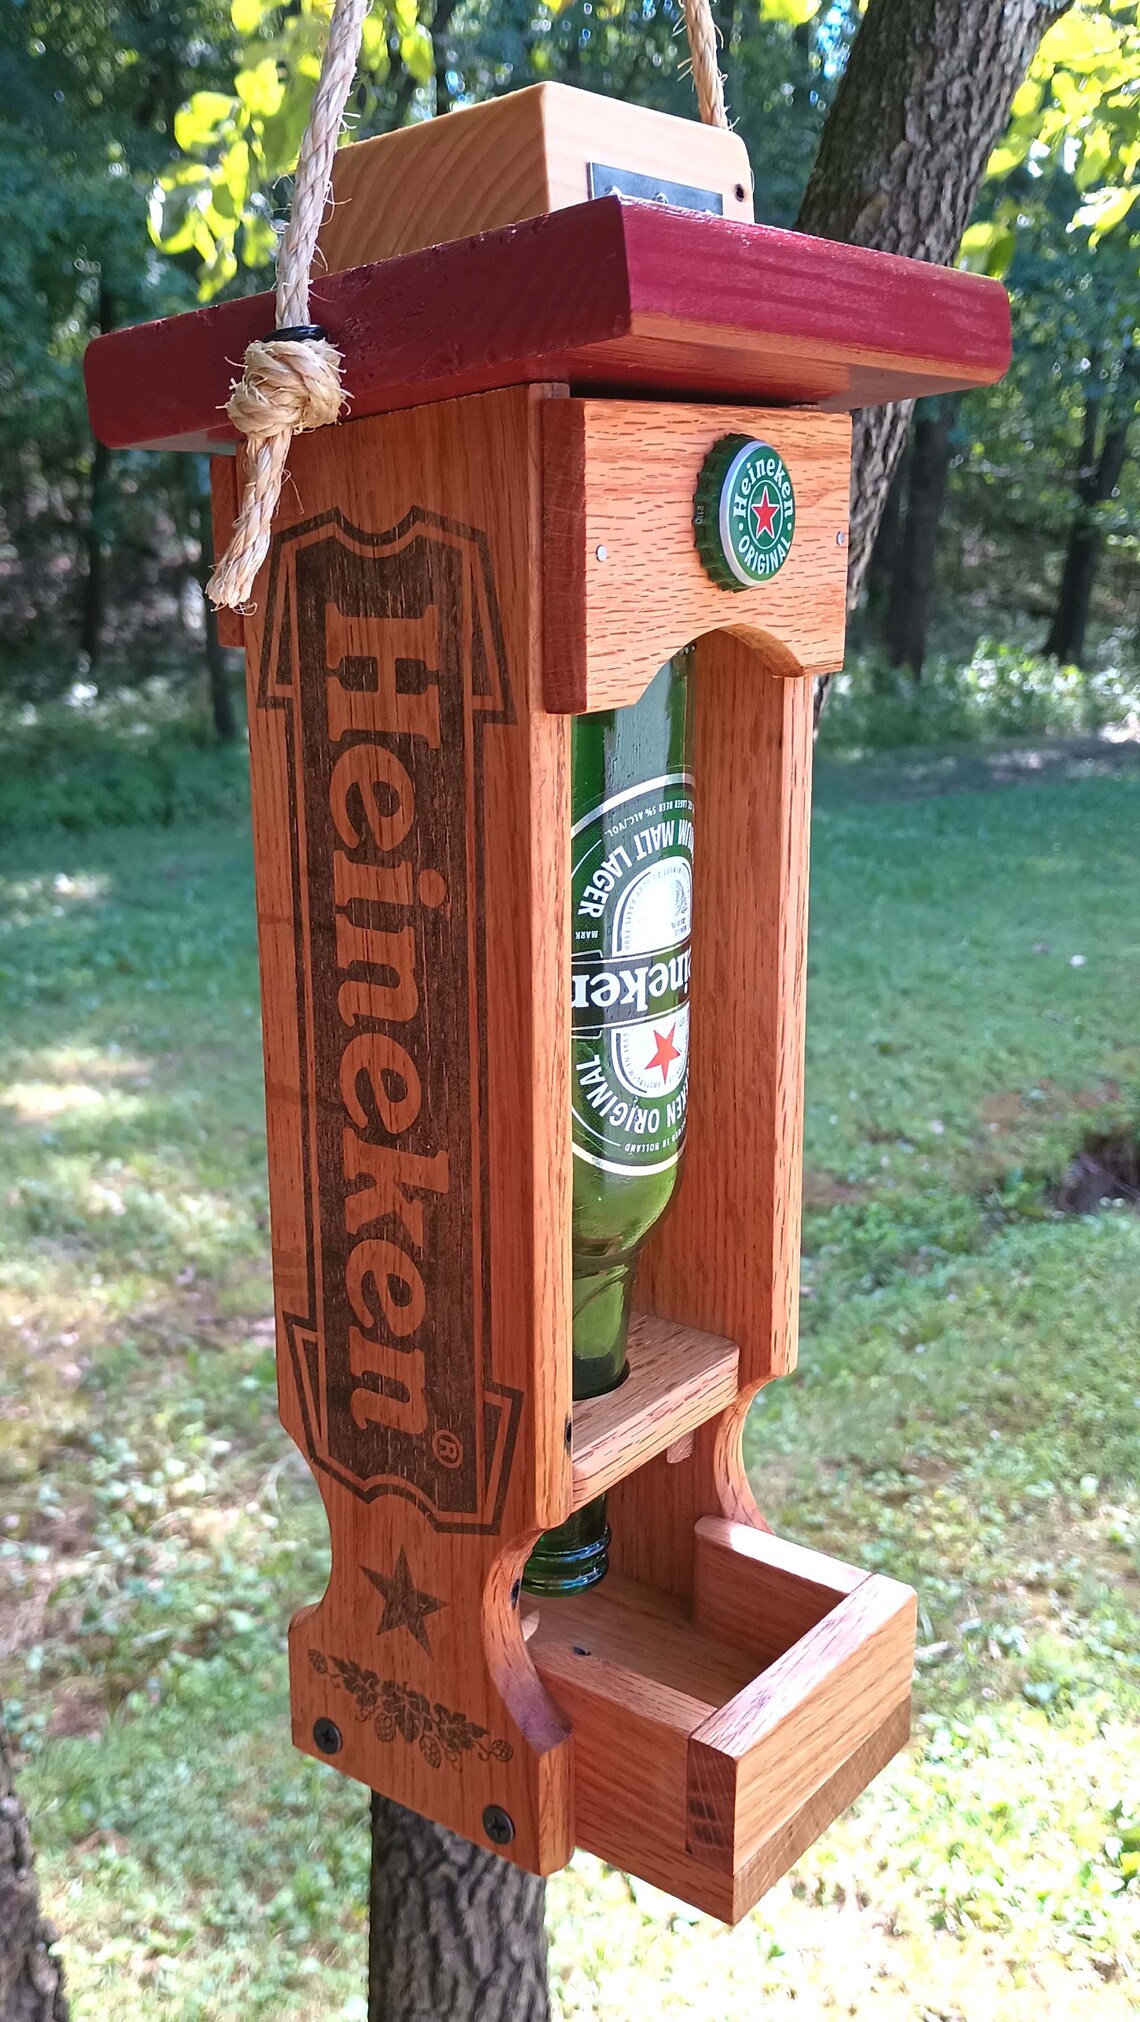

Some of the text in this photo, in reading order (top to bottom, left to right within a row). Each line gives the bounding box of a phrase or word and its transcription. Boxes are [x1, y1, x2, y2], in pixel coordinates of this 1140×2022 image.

[733, 457, 794, 519] Heineken
[738, 535, 791, 575] ORIGINAL
[644, 805, 657, 817] 5%
[658, 800, 673, 812] BEER
[674, 799, 687, 808] LAGER
[633, 820, 675, 861] MALT
[577, 844, 633, 919] LAGER
[575, 930, 598, 940] MARK
[325, 602, 450, 1434] Heineken
[575, 1054, 660, 1134] ORIGINAL
[624, 1142, 659, 1153] HOLLAND
[662, 1137, 670, 1148] IN
